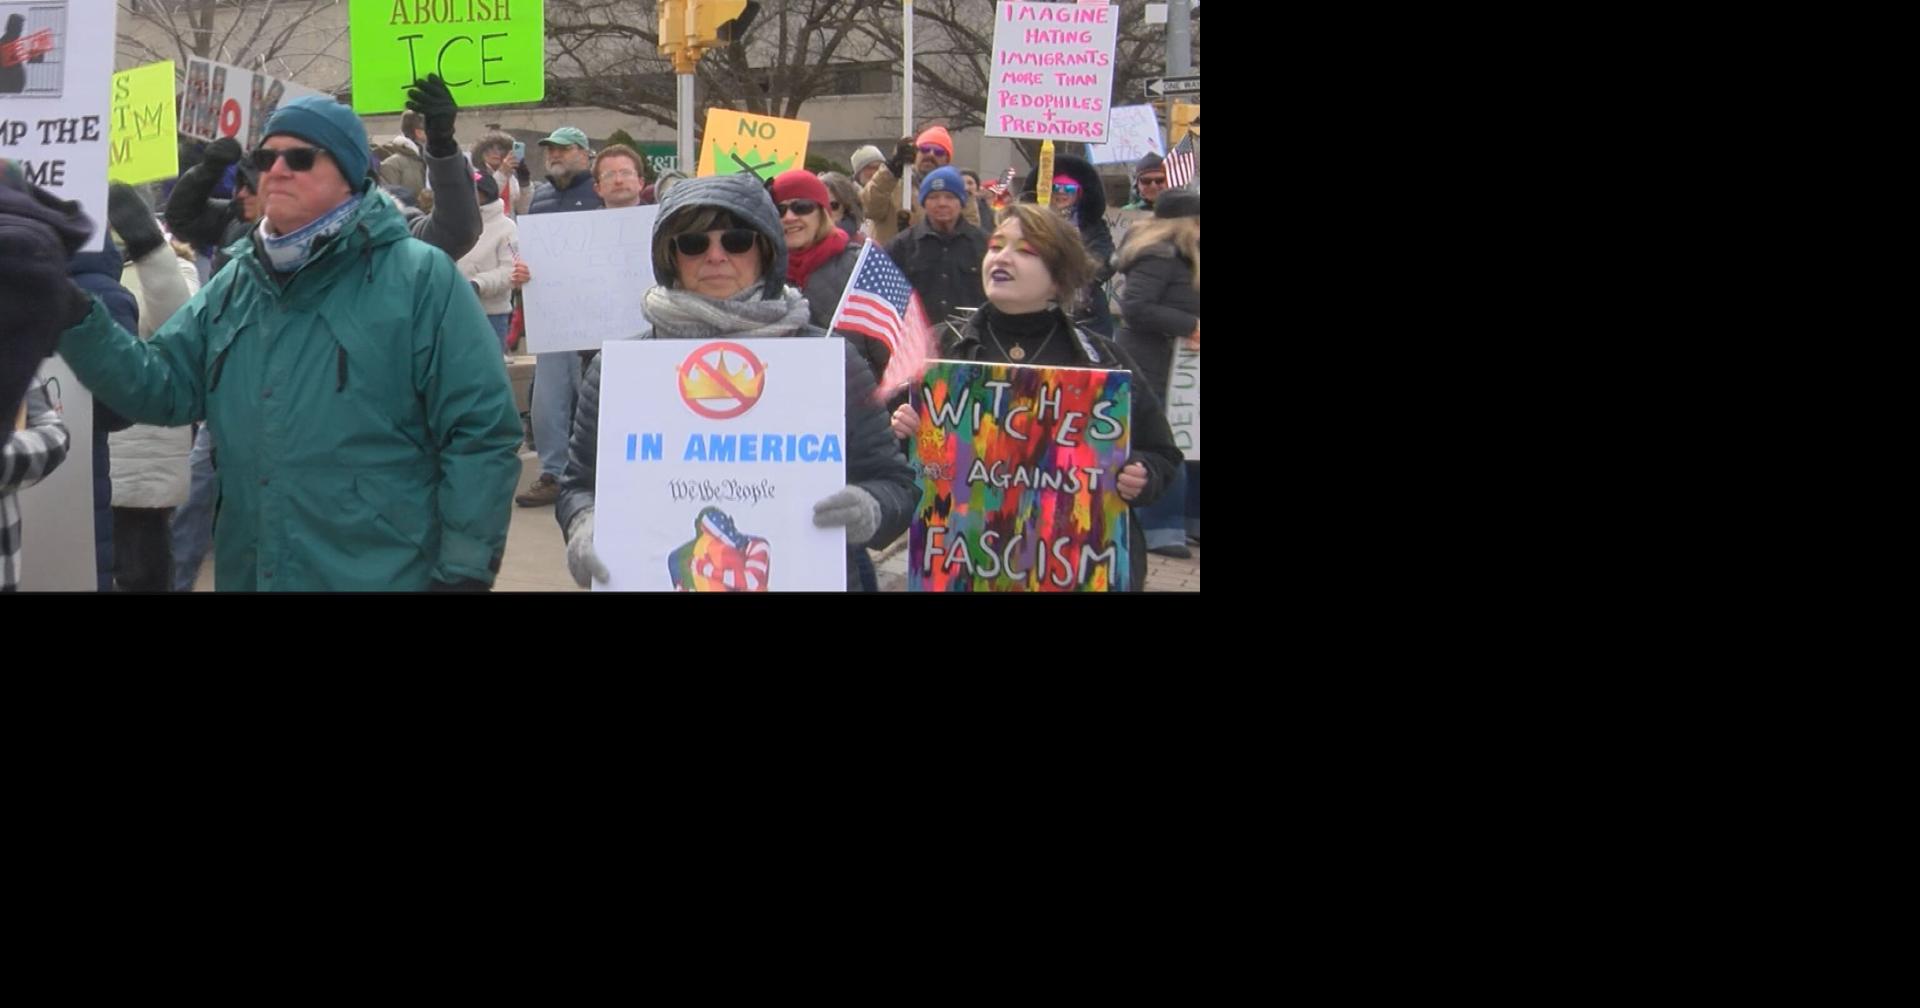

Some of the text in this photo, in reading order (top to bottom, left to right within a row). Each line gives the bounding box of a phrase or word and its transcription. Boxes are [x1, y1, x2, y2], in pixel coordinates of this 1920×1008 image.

[390, 0, 512, 25] ABOLISH
[1006, 4, 1109, 24] IMAGINE
[1025, 28, 1093, 45] HATING
[999, 50, 1109, 67] IMMIGRANTS
[1002, 71, 1097, 86] MORE THAN
[998, 89, 1103, 112] PEDOPHILES
[36, 115, 100, 145] THE
[738, 117, 776, 140] NO
[1000, 114, 1104, 138] PREDATORS
[922, 380, 1124, 448] WITCHES
[626, 432, 843, 462] IN AMERICA
[967, 456, 1104, 495] AGAINST
[722, 478, 776, 506] People
[922, 525, 1117, 587] FASCISM
